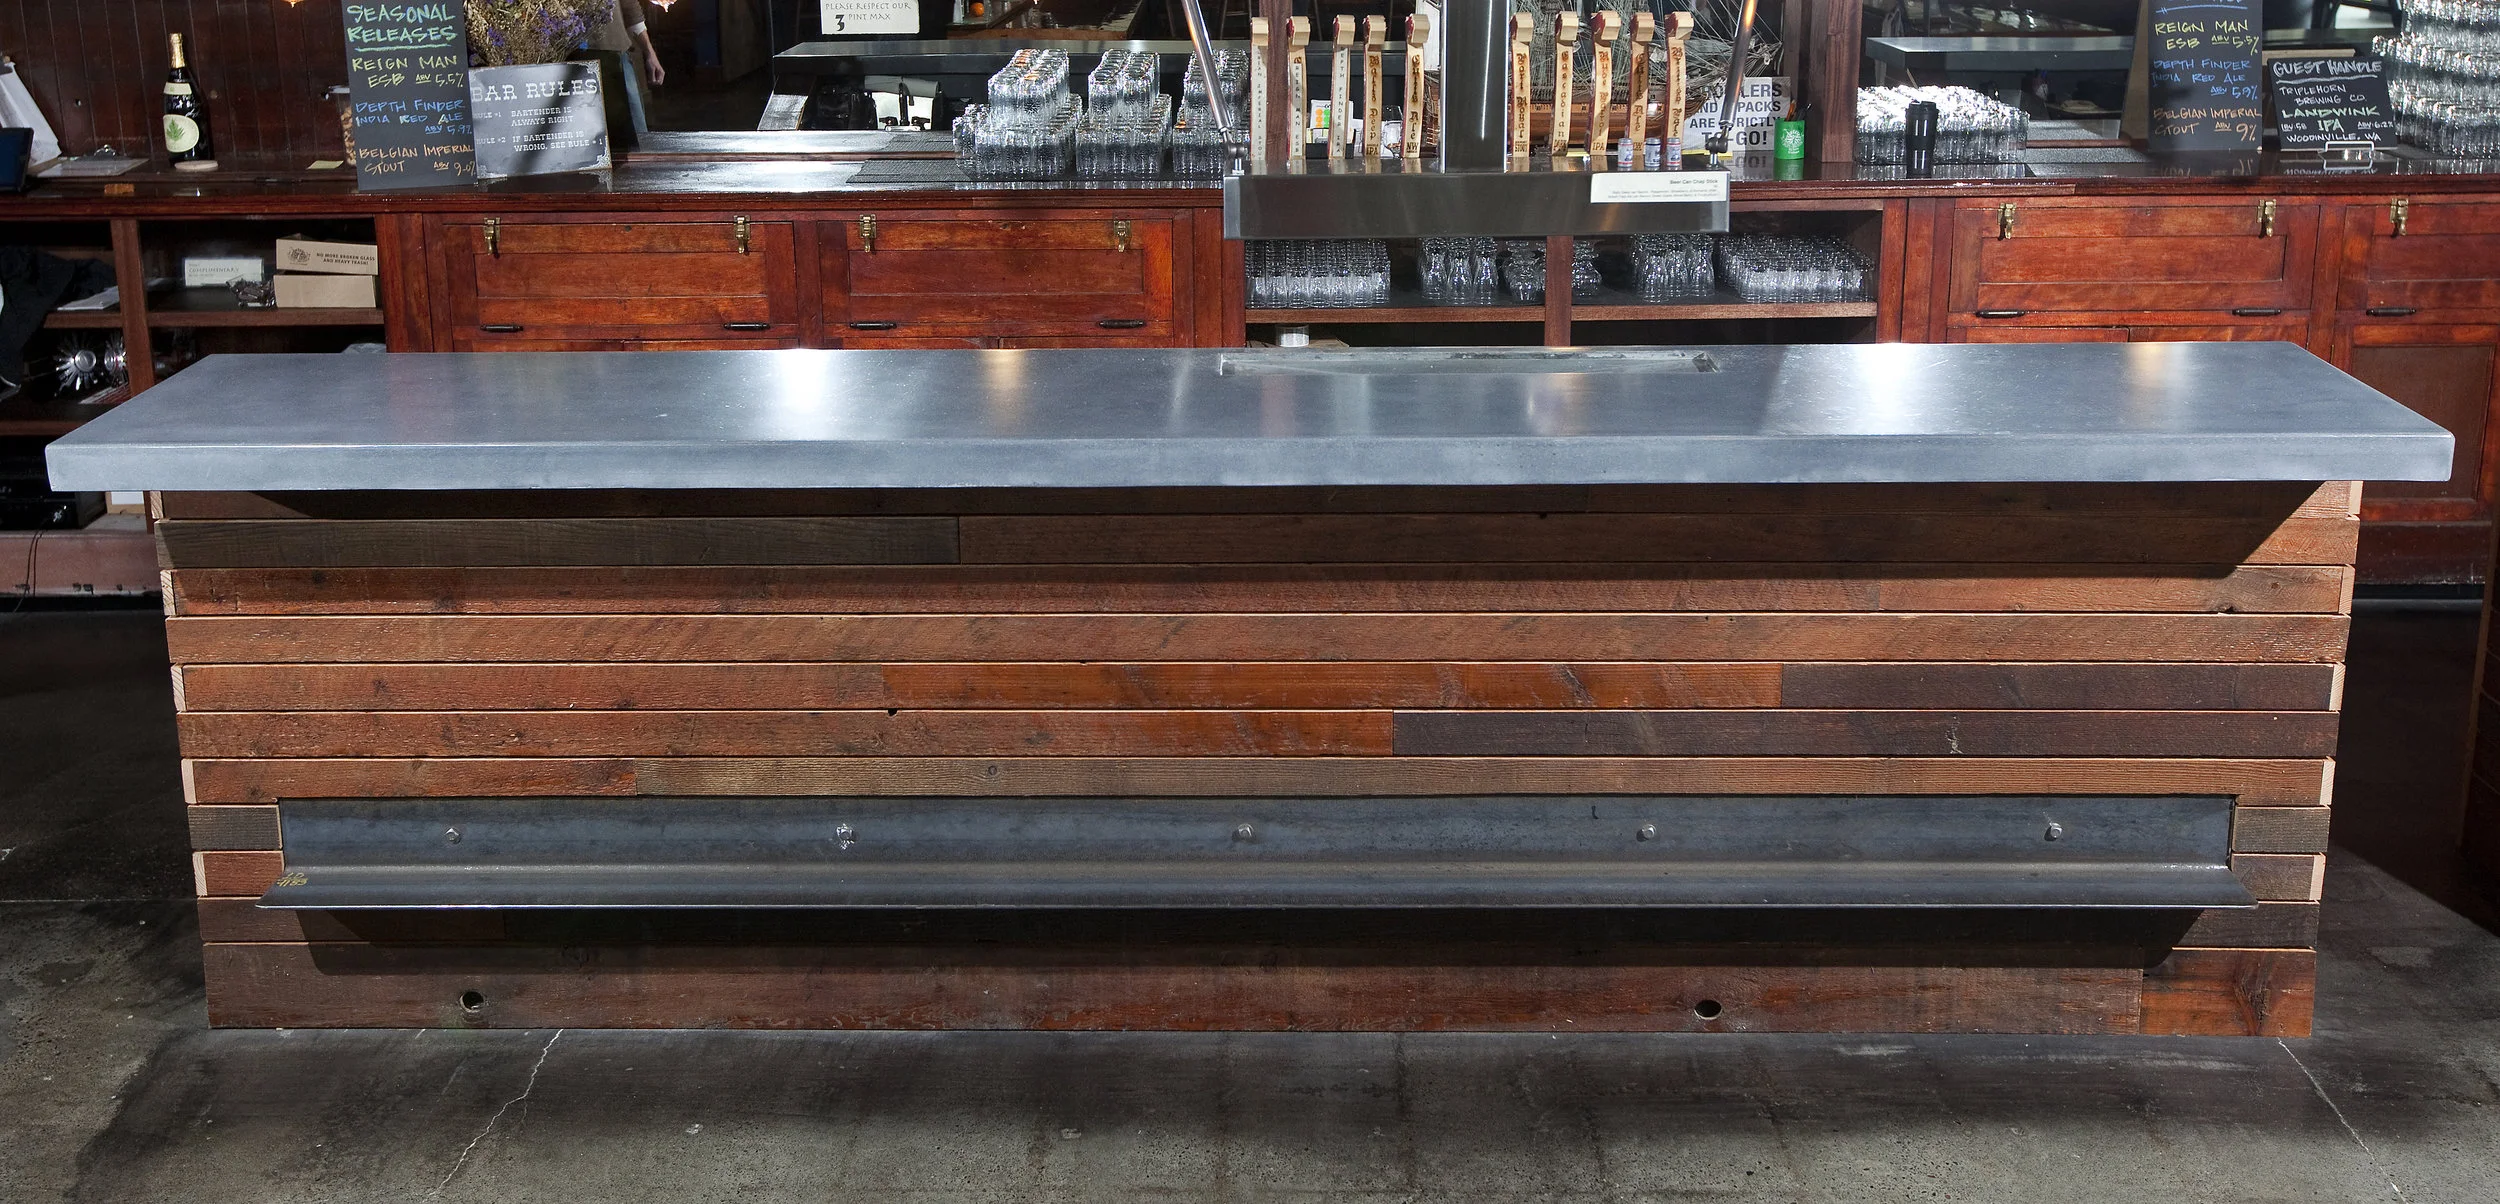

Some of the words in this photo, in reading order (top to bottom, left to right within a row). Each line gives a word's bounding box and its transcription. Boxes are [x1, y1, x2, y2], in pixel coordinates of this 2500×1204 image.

[347, 4, 456, 23] SEASONAL
[835, 14, 845, 32] 3
[2155, 21, 2205, 36] REIGN
[2215, 19, 2248, 33] MAN
[347, 25, 458, 44] RELEASES
[2166, 38, 2200, 50] ESB
[2211, 35, 2229, 44] ABV
[2233, 35, 2259, 56] 5.5%
[352, 58, 408, 72] REIGN
[419, 55, 457, 69] MAN
[2153, 59, 2194, 70] DEPTH
[2202, 59, 2251, 70] FINDER
[2273, 61, 2325, 77] GUEST
[2327, 60, 2382, 75] HANDLE
[368, 73, 405, 88] ESB
[416, 74, 432, 84] ABV
[435, 72, 464, 88] 5.5%
[2152, 72, 2180, 87] INDIA
[2192, 73, 2215, 83] RED
[2224, 73, 2245, 84] ALE
[471, 84, 518, 102] BAR
[525, 79, 598, 99] RULES
[2211, 85, 2227, 95] ABV
[2279, 84, 2346, 96] TRIPLEHORN
[355, 101, 406, 114] DEPTH
[414, 99, 465, 112] FINDER
[2294, 94, 2341, 106] BREWING
[511, 108, 562, 118] BARTENDER
[1699, 103, 1718, 113] ND
[2153, 108, 2207, 119] BELGIAN
[2210, 108, 2262, 118] IMPERIAL
[2282, 106, 2380, 118] LANDWINK
[355, 114, 390, 127] INDIA
[400, 115, 428, 124] RED
[438, 112, 463, 125] ALE
[511, 118, 545, 127] ALWAYS
[548, 115, 574, 124] RIGHT
[1690, 118, 1715, 128] ARE
[2318, 119, 2344, 133] IPA
[425, 125, 442, 134] ABV
[447, 125, 472, 135] 5.9%
[476, 137, 496, 145] RULE
[512, 135, 521, 143] IF
[523, 131, 574, 142] BARTENDER
[576, 130, 585, 138] IS
[2154, 122, 2199, 136] STOUT
[2215, 121, 2231, 131] ABV
[2236, 123, 2256, 141] 9%
[2364, 132, 2381, 141] WA
[359, 147, 418, 159] BELGIAN
[423, 144, 474, 157] IMPERIAL
[551, 140, 566, 149] SEE
[568, 139, 590, 148] RULE
[1592, 142, 1604, 151] IPA
[364, 160, 405, 176] STOUT
[433, 161, 449, 170] ABV
